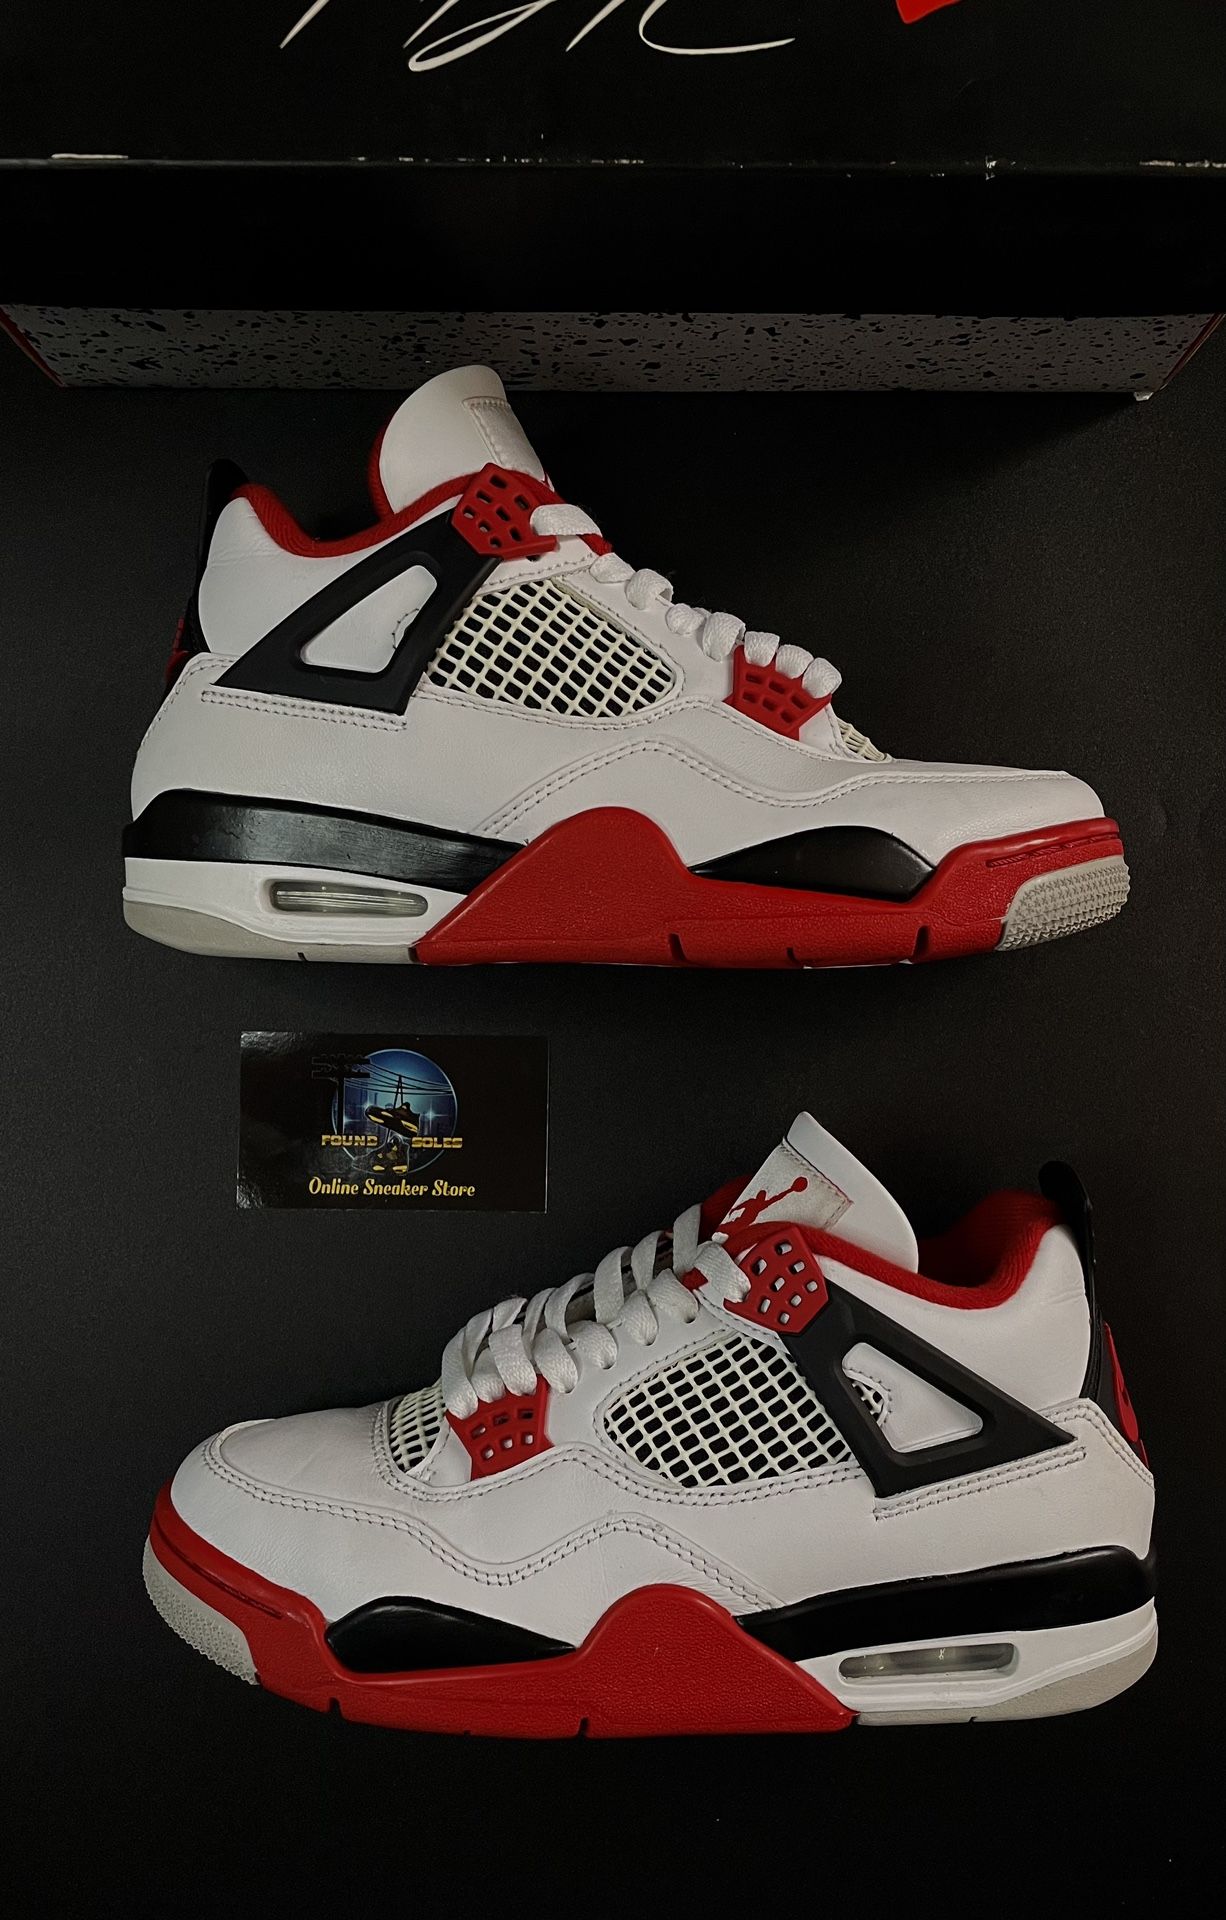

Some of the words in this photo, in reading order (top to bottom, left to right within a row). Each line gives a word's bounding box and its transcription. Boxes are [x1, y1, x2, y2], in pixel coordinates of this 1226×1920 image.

[321, 1135, 378, 1147] FOUND
[411, 1137, 463, 1149] SOLES
[308, 1176, 359, 1195] Online
[363, 1178, 429, 1196] Sneaker
[431, 1179, 476, 1197] Store
